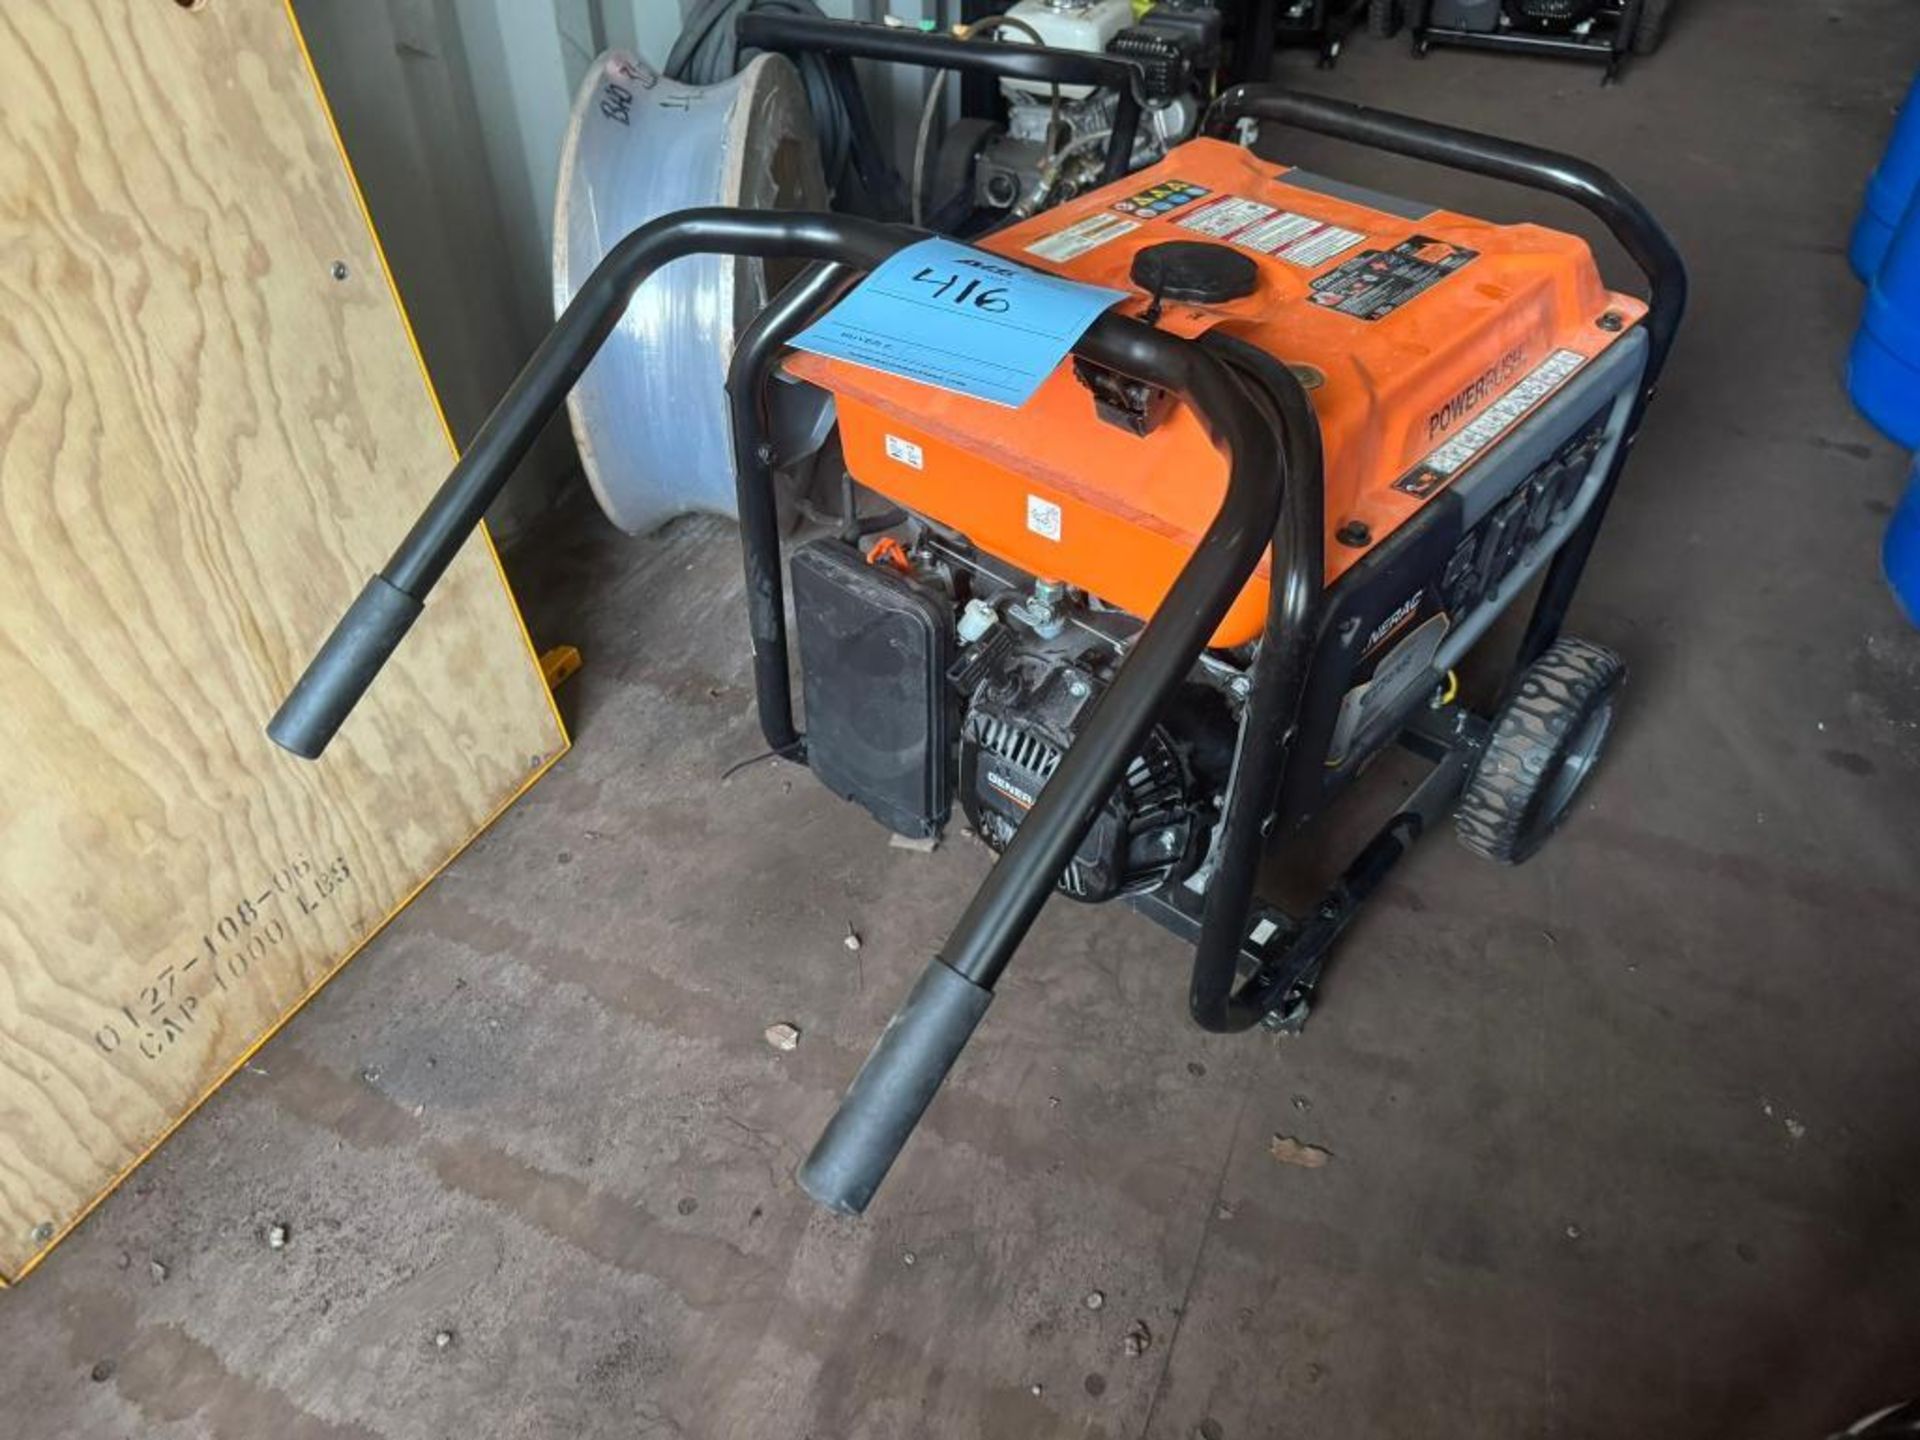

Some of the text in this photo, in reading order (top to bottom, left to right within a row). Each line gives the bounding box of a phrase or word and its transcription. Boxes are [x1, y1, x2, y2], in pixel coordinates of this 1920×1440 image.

[912, 267, 1010, 313] 416
[96, 856, 311, 1053] 0127-108-06
[140, 857, 350, 1059] CAP 1000 LBS
